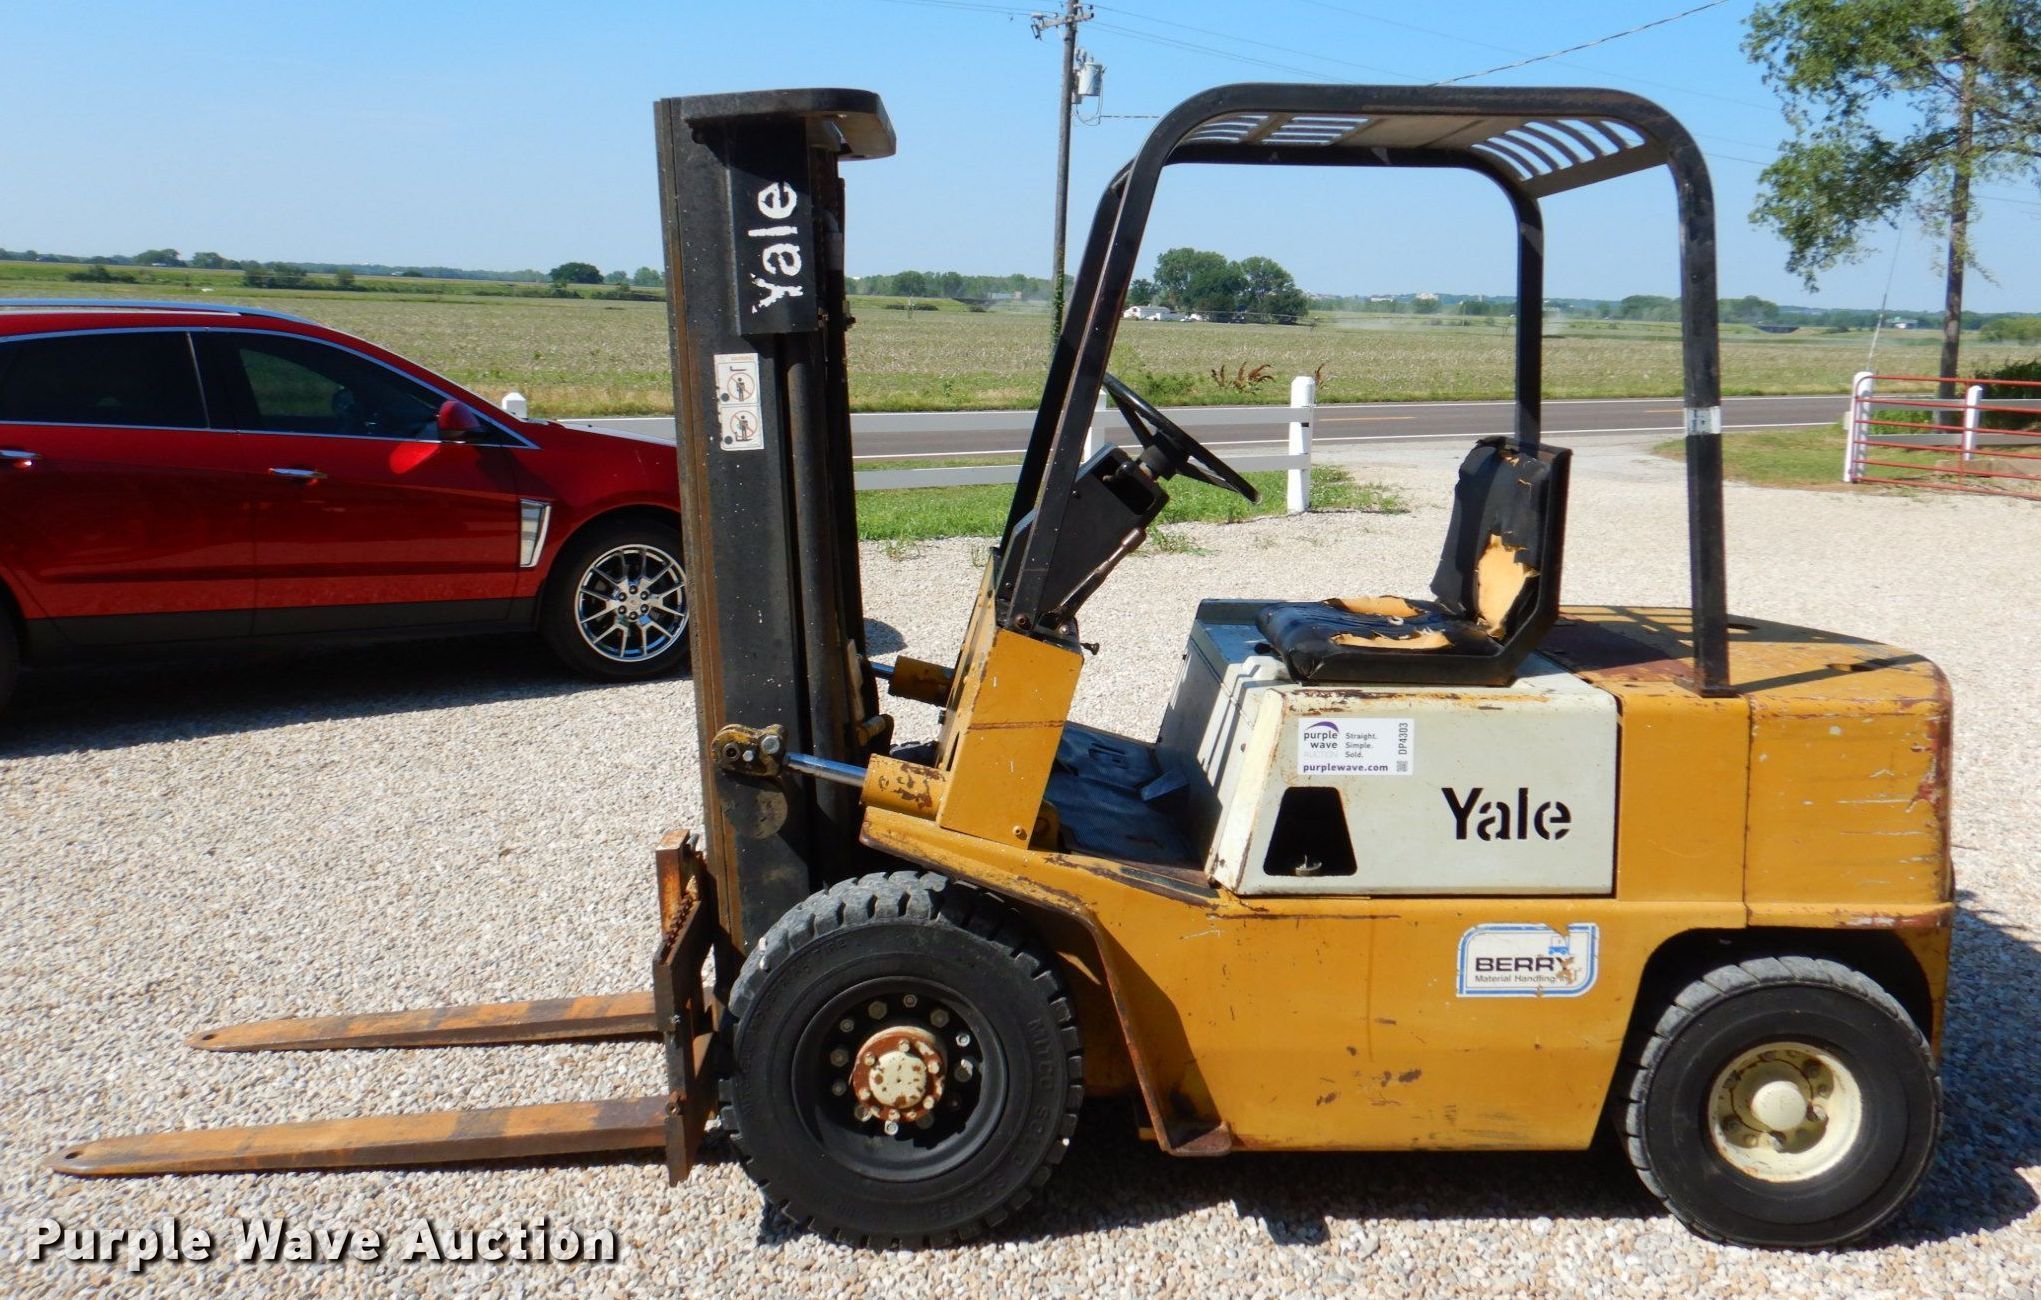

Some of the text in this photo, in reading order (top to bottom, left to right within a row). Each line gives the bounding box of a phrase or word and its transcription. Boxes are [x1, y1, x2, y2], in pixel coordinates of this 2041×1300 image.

[748, 181, 804, 314] Yale
[1303, 730, 1338, 741] purple
[1345, 732, 1378, 741] Straight.
[1398, 722, 1408, 755] DP4303
[1345, 741, 1375, 749] Simple.
[1303, 763, 1388, 773] purplewave.com
[1441, 787, 1571, 841] Yale
[1475, 957, 1575, 971] BERRY
[1475, 974, 1511, 983] Material
[1514, 974, 1556, 984] Handling
